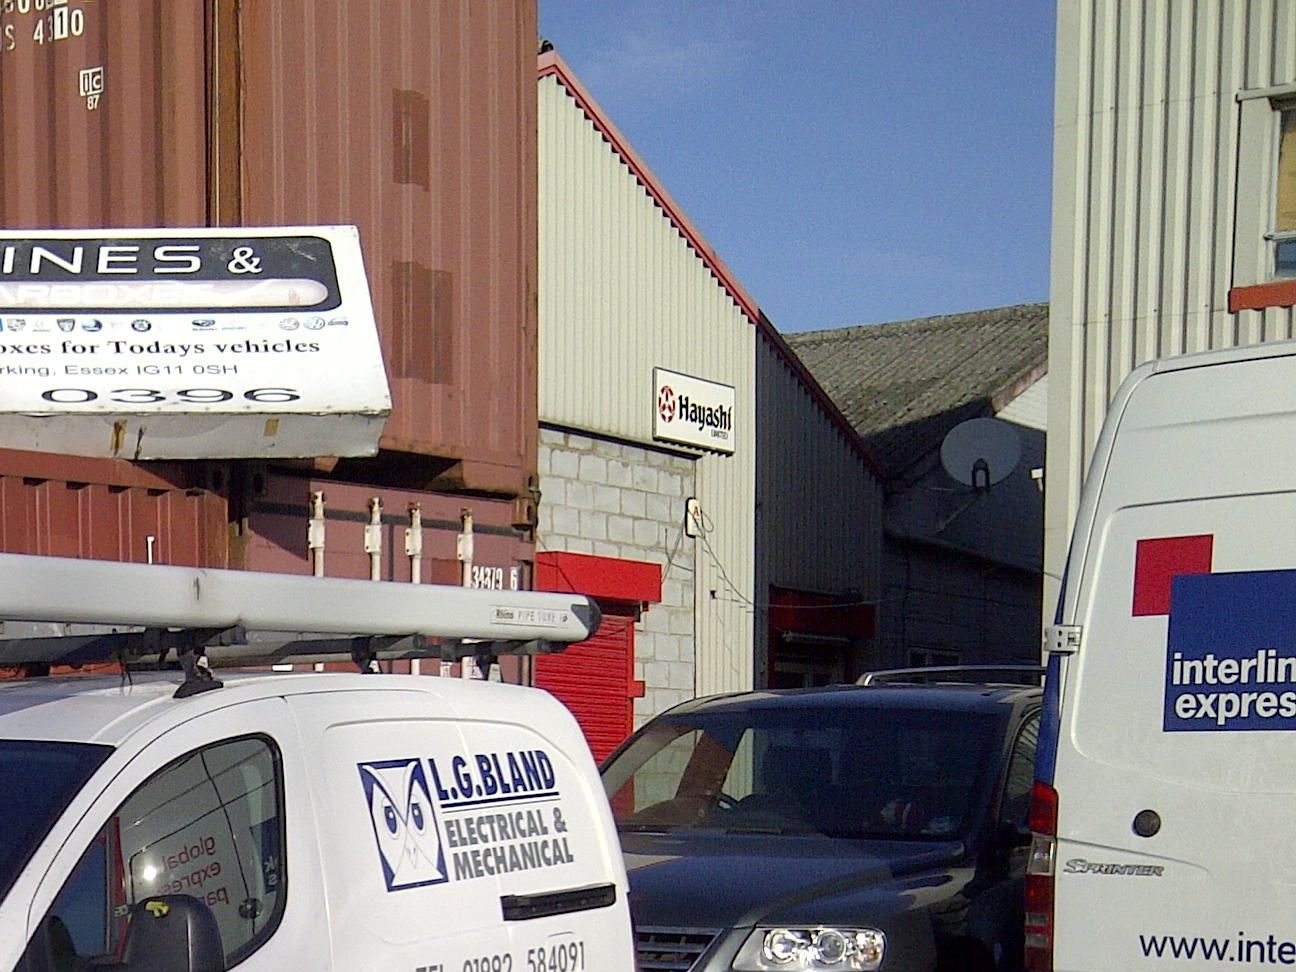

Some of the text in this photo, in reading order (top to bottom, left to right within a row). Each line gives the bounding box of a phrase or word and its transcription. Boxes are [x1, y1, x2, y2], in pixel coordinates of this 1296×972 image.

[87, 95, 100, 110] 87
[227, 246, 263, 274] &
[62, 340, 100, 354] for
[107, 340, 205, 357] Todays
[216, 339, 320, 354] vehicles
[65, 364, 128, 375] Essex
[137, 365, 183, 375] IG11
[42, 387, 301, 403] 0396
[678, 394, 732, 431] Hayashi
[1172, 649, 1296, 686] interlin
[1175, 691, 1296, 726] expres
[428, 750, 556, 800] L.G.BLAND
[444, 806, 568, 849] ELECTRICAL &
[453, 837, 574, 881] MECHANICAL
[1139, 931, 1296, 965] www.inte
